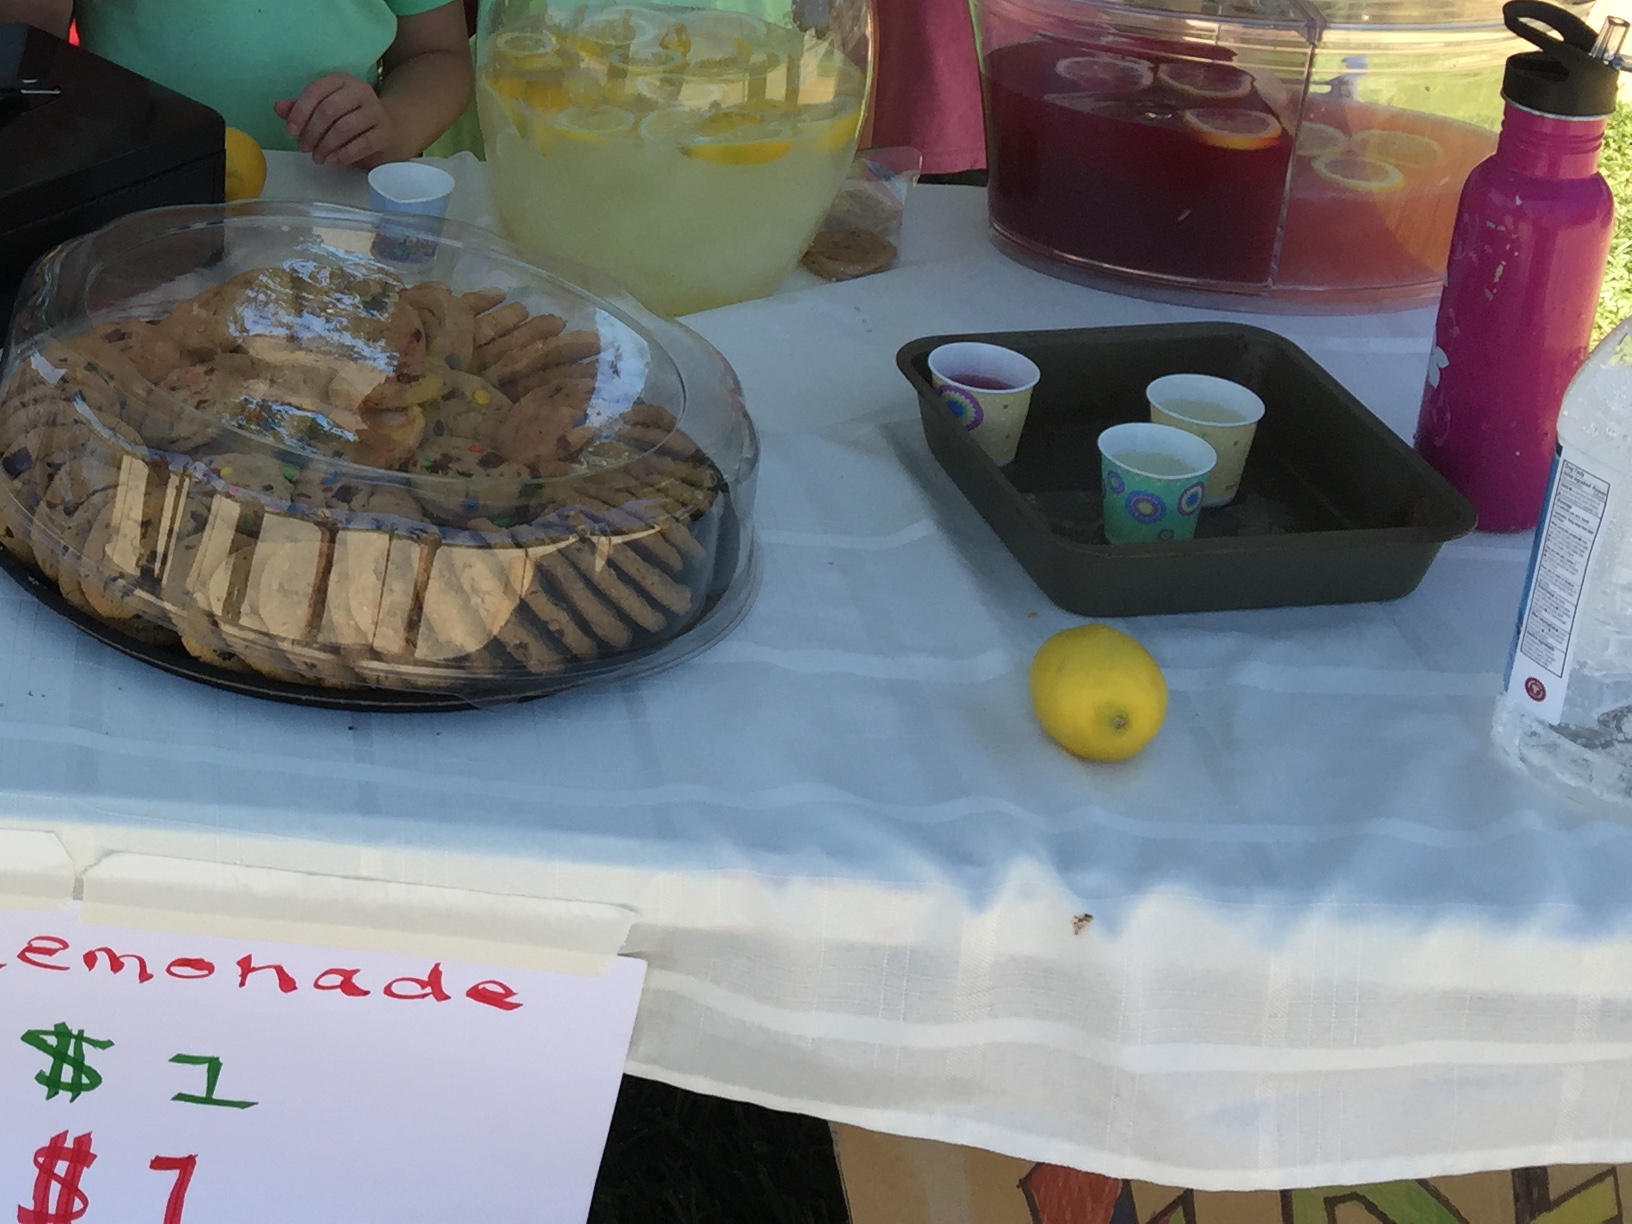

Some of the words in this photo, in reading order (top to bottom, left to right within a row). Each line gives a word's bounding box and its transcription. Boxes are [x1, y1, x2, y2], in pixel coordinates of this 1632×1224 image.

[20, 1021, 115, 1101] $
[170, 1052, 260, 1110] 1
[16, 1131, 98, 1224] $
